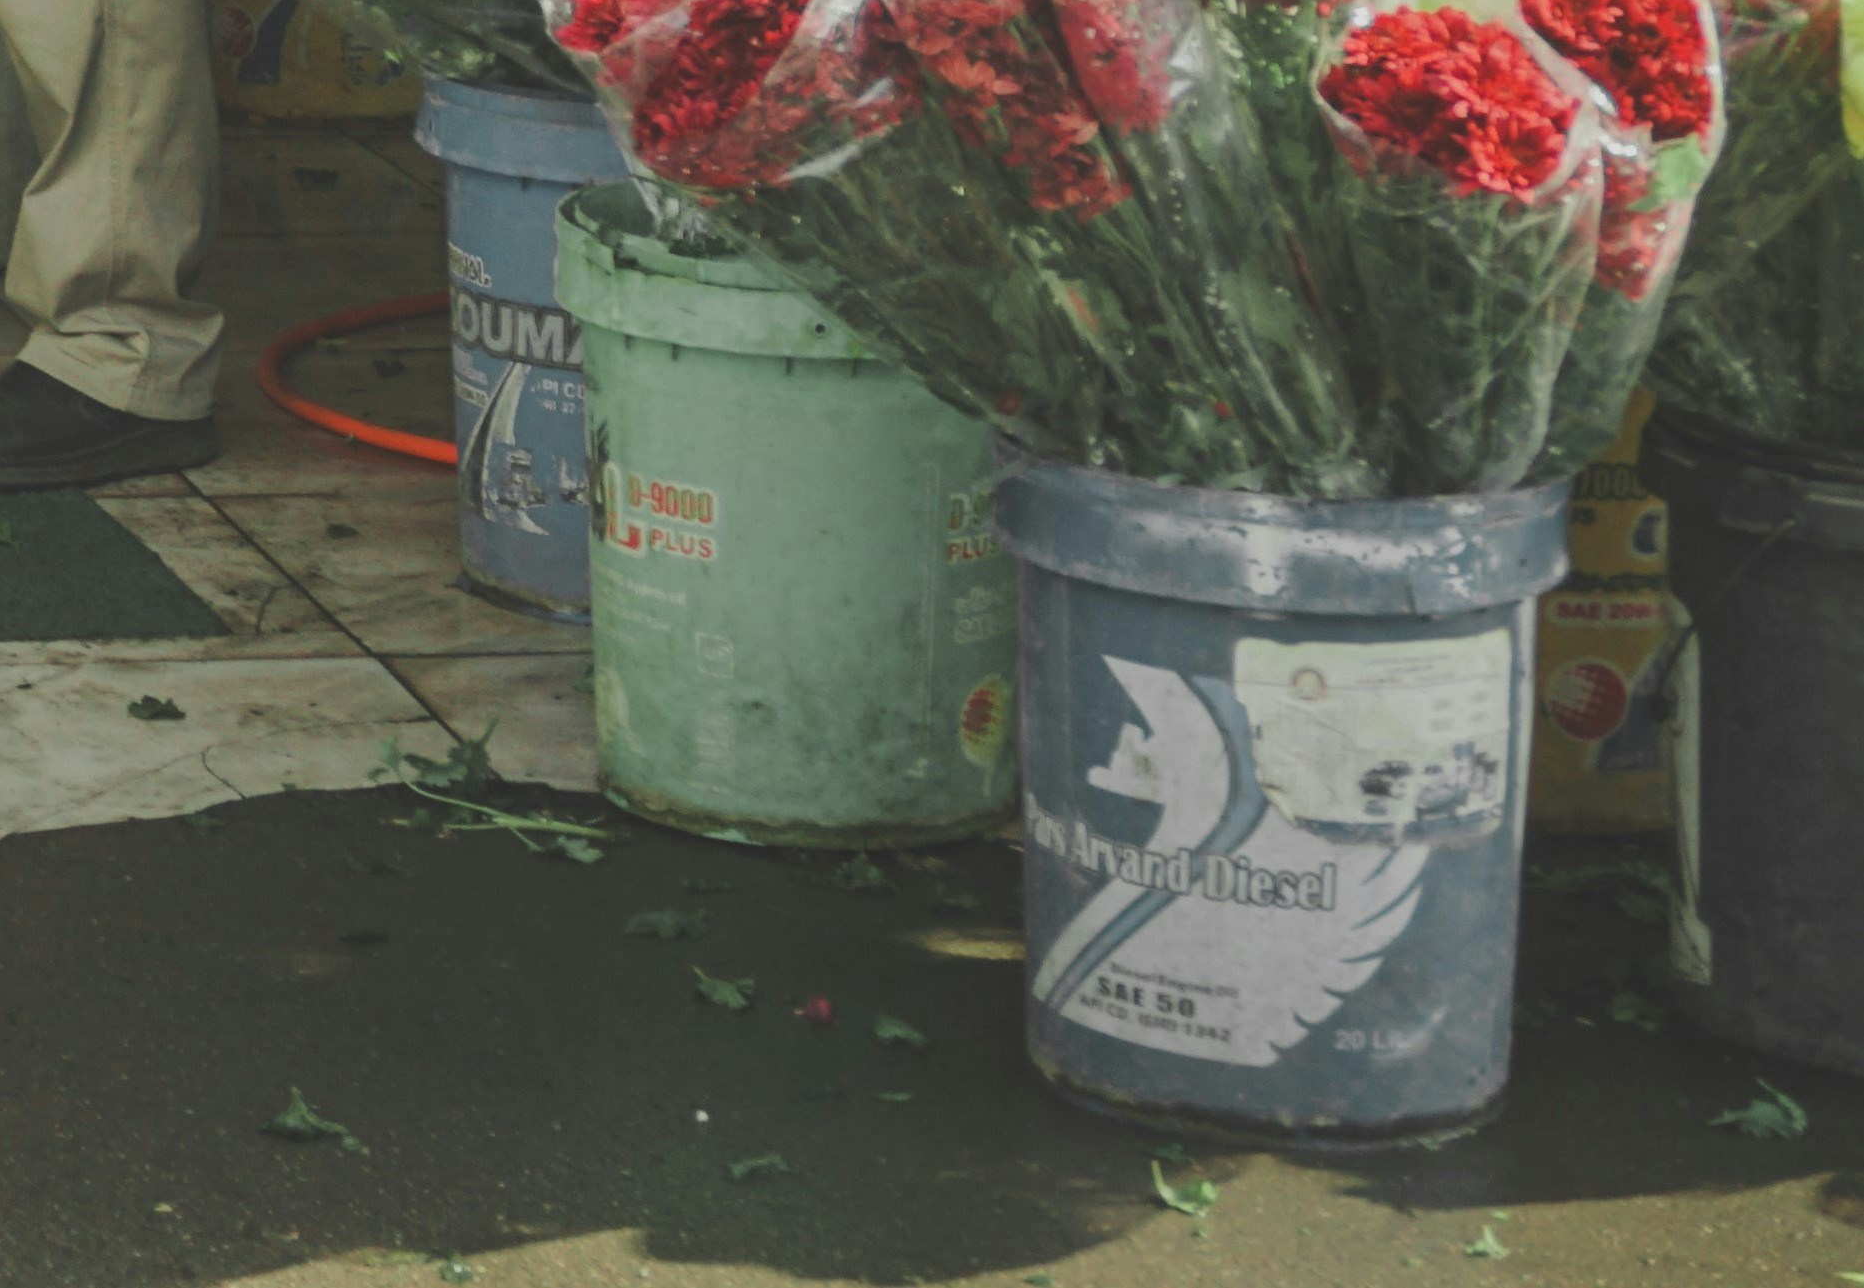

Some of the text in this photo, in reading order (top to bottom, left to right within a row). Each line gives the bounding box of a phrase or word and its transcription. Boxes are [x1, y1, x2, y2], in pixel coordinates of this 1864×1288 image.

[649, 529, 717, 560] PLUS
[1071, 820, 1194, 896] Arvand
[1202, 853, 1337, 912] Diesel
[1097, 975, 1197, 1019] SAE 50
[1334, 1029, 1366, 1052] 20
